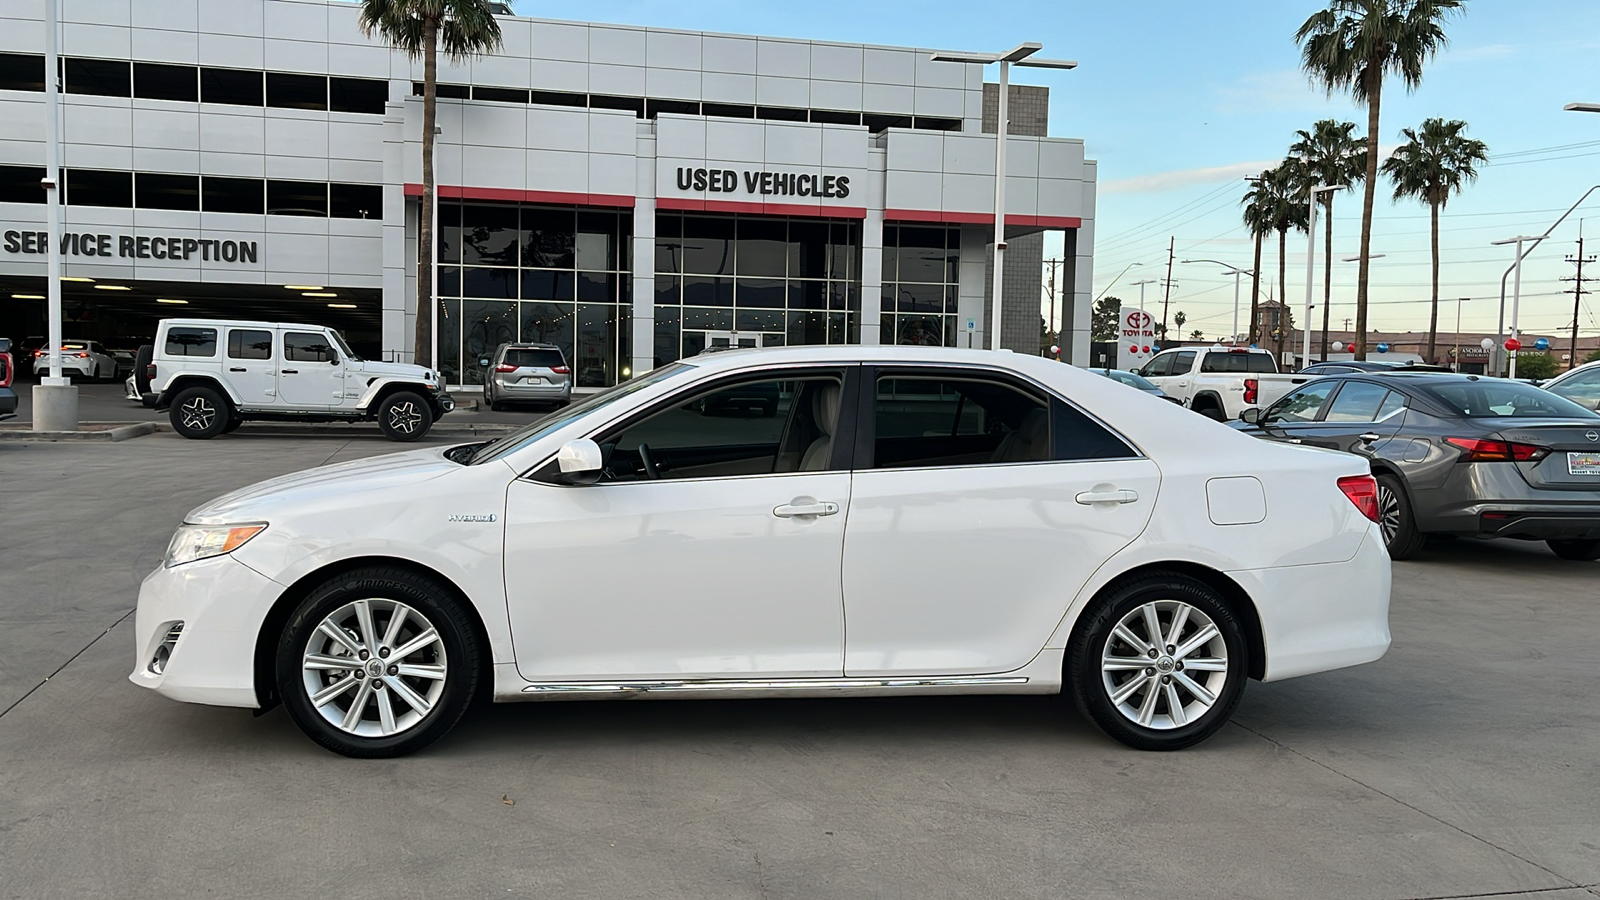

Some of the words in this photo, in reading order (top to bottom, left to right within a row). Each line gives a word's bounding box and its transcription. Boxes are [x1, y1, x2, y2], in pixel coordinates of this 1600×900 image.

[677, 167, 737, 192] USED
[744, 171, 850, 198] VEHICLES
[119, 235, 257, 263] RECEPTION
[355, 579, 431, 603] BRIDGESTONE
